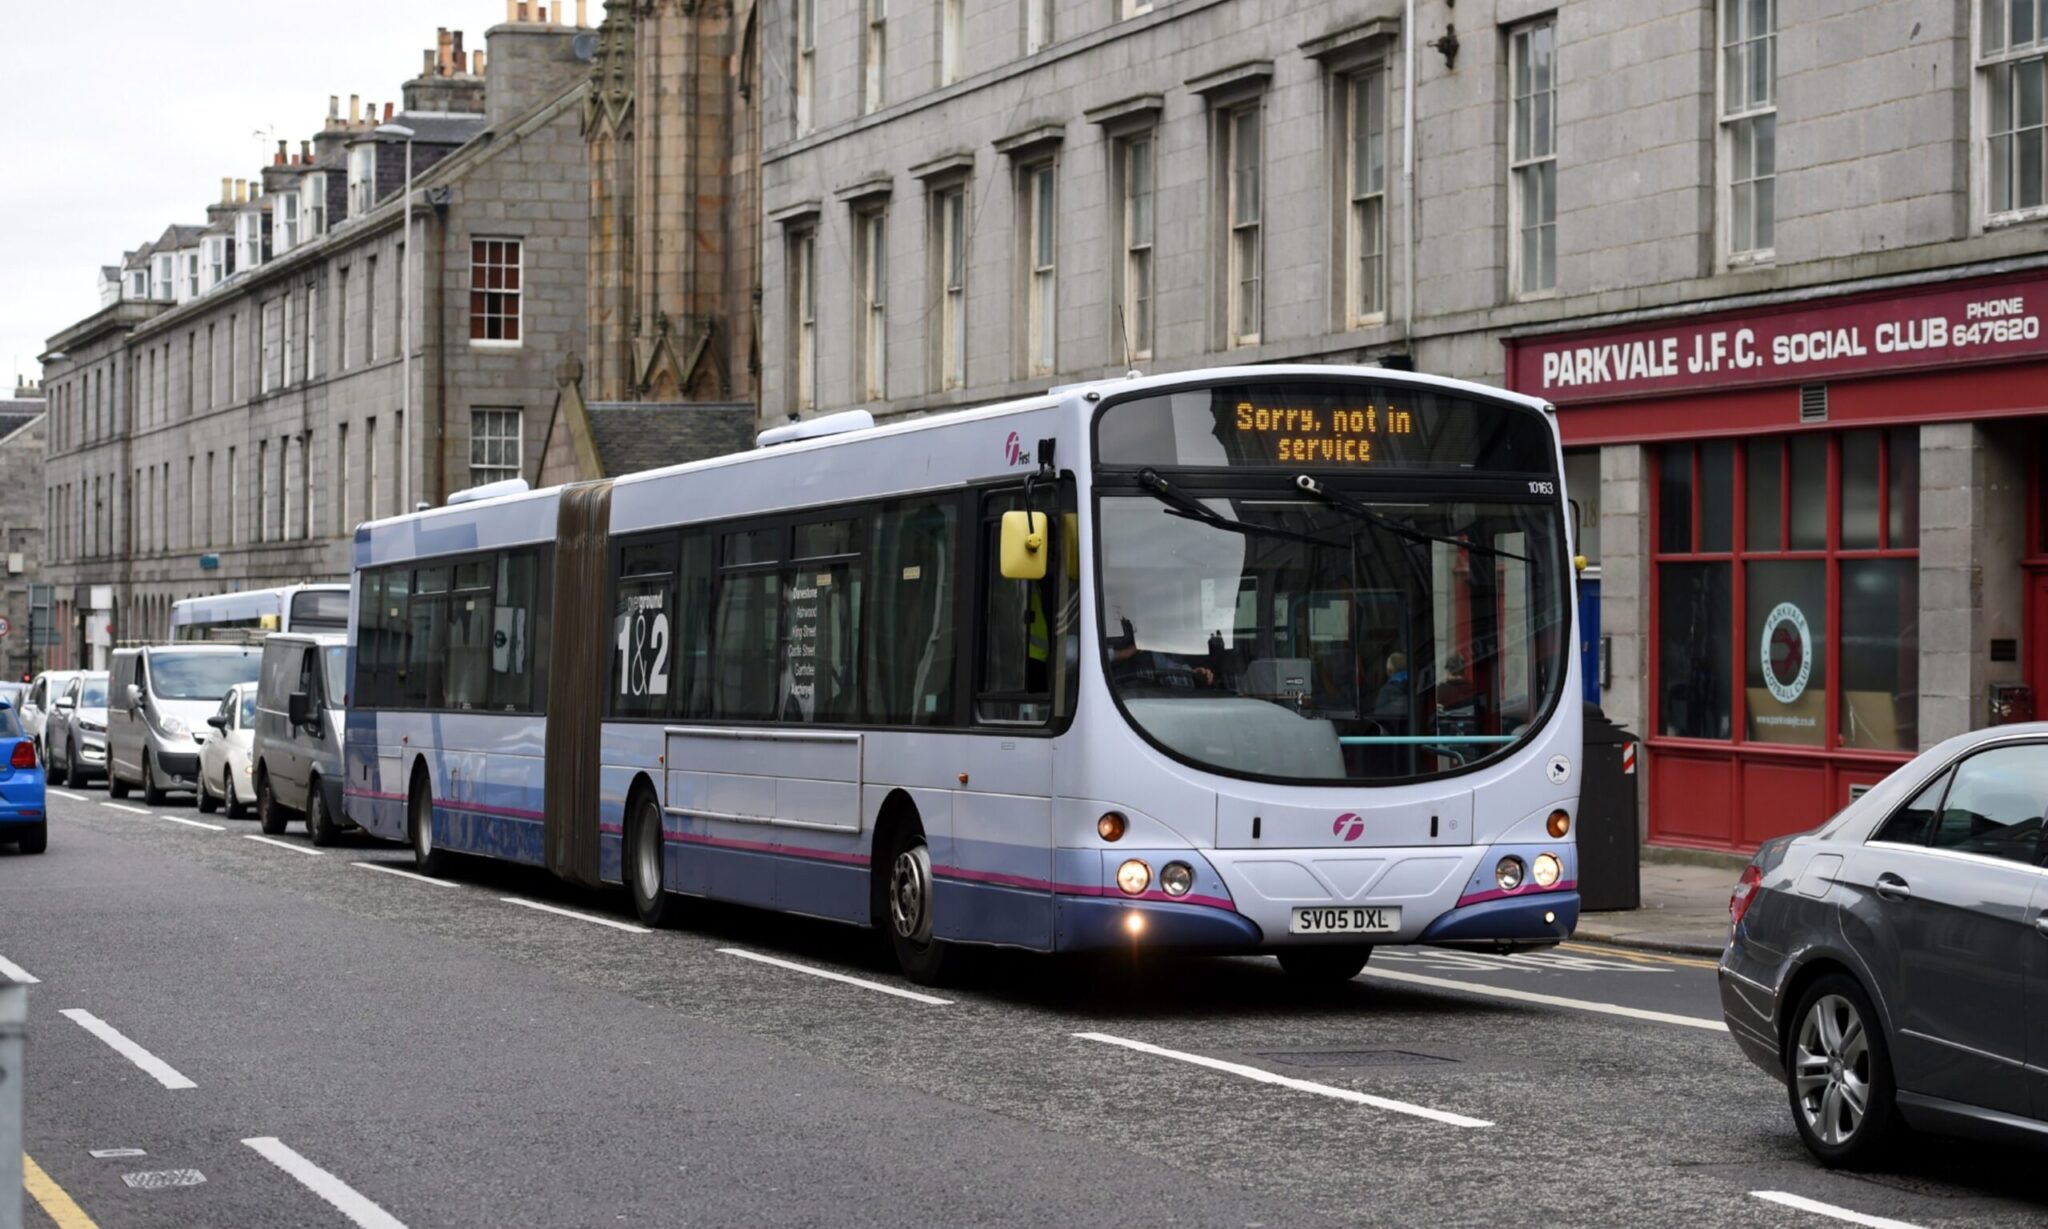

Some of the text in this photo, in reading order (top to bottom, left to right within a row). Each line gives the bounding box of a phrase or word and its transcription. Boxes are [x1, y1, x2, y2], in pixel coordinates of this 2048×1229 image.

[1966, 297, 2024, 320] PHONE
[1952, 316, 2039, 348] 647620
[1543, 316, 1948, 389] PARKVALE J.F.C. SOCIAL CLUB
[1236, 402, 1411, 434] Sorry, not in
[1278, 434, 1371, 462] service
[1528, 481, 1554, 494] 10163
[1768, 606, 1805, 631] PARKVALE
[1764, 659, 1809, 699] FOOTBALL CLUB
[1300, 909, 1389, 930] SV05 DXL
